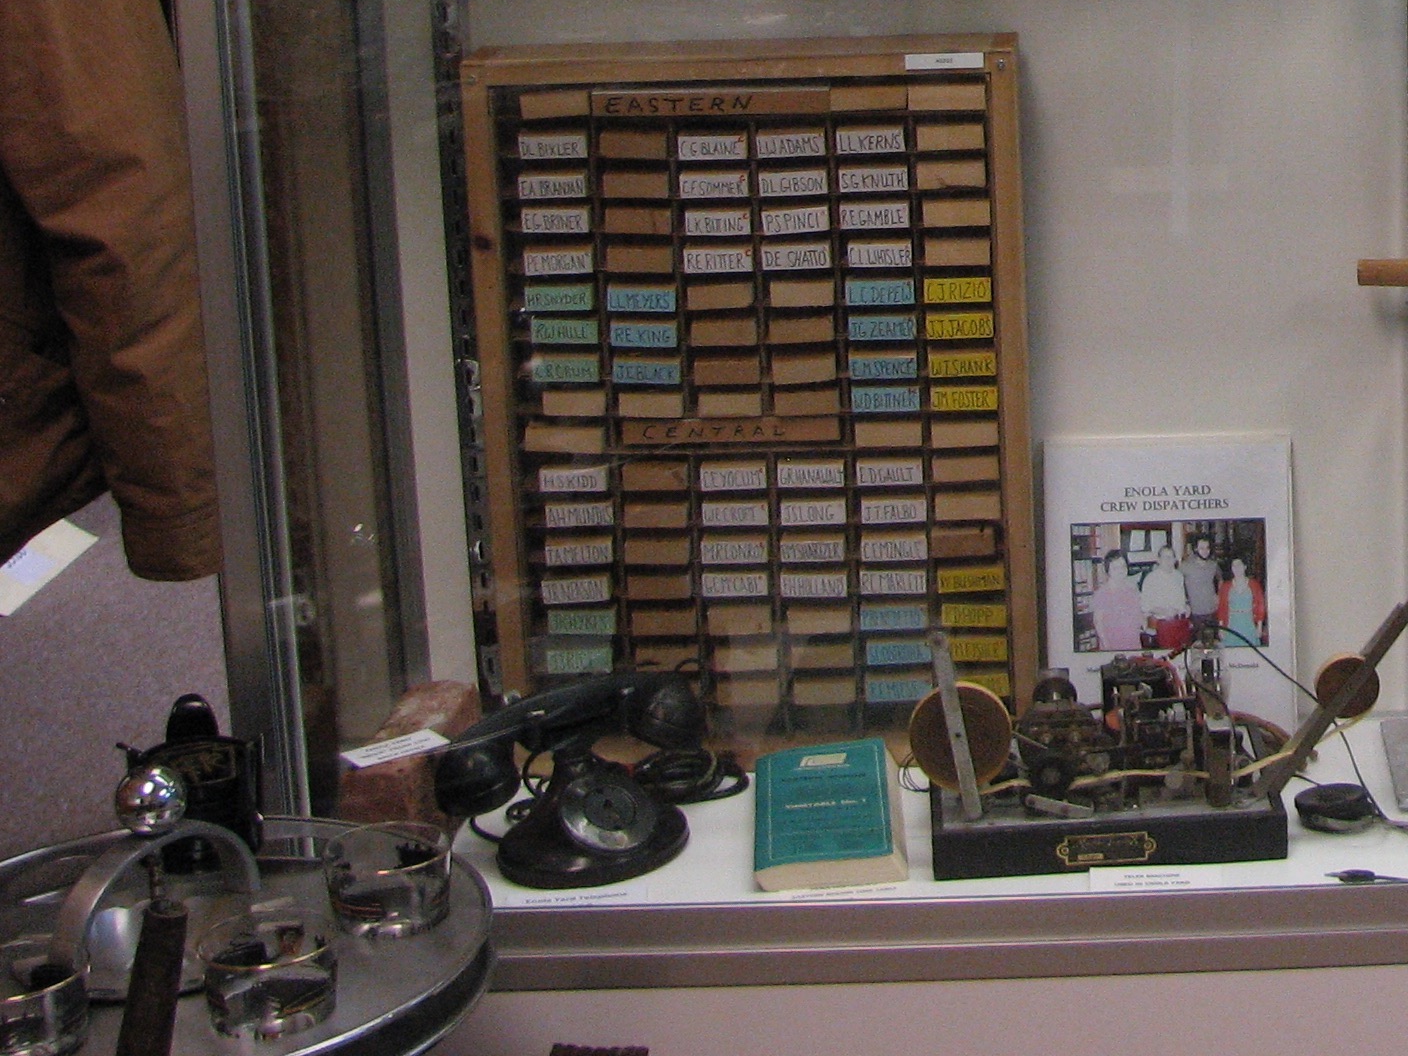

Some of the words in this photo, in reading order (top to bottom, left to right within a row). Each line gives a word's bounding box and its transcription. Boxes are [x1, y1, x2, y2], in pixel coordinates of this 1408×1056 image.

[605, 95, 753, 115] EASTERN
[779, 137, 820, 154] ADAMS
[858, 133, 901, 150] KERNS
[780, 177, 823, 193] GIBSON
[861, 173, 905, 189] KNUTH
[784, 212, 820, 230] PINCI
[859, 209, 905, 226] GAMBLE
[704, 253, 745, 270] RITTER
[948, 282, 987, 300] RIZIO
[637, 329, 670, 343] KING
[947, 319, 993, 338] JACOBS
[951, 391, 991, 408] FOSTER
[642, 425, 787, 439] CENTRAL
[1124, 486, 1169, 498] ENOLA
[1173, 484, 1211, 496] YARD
[1100, 502, 1137, 513] CREW
[1143, 499, 1229, 512] DISPATCHERS
